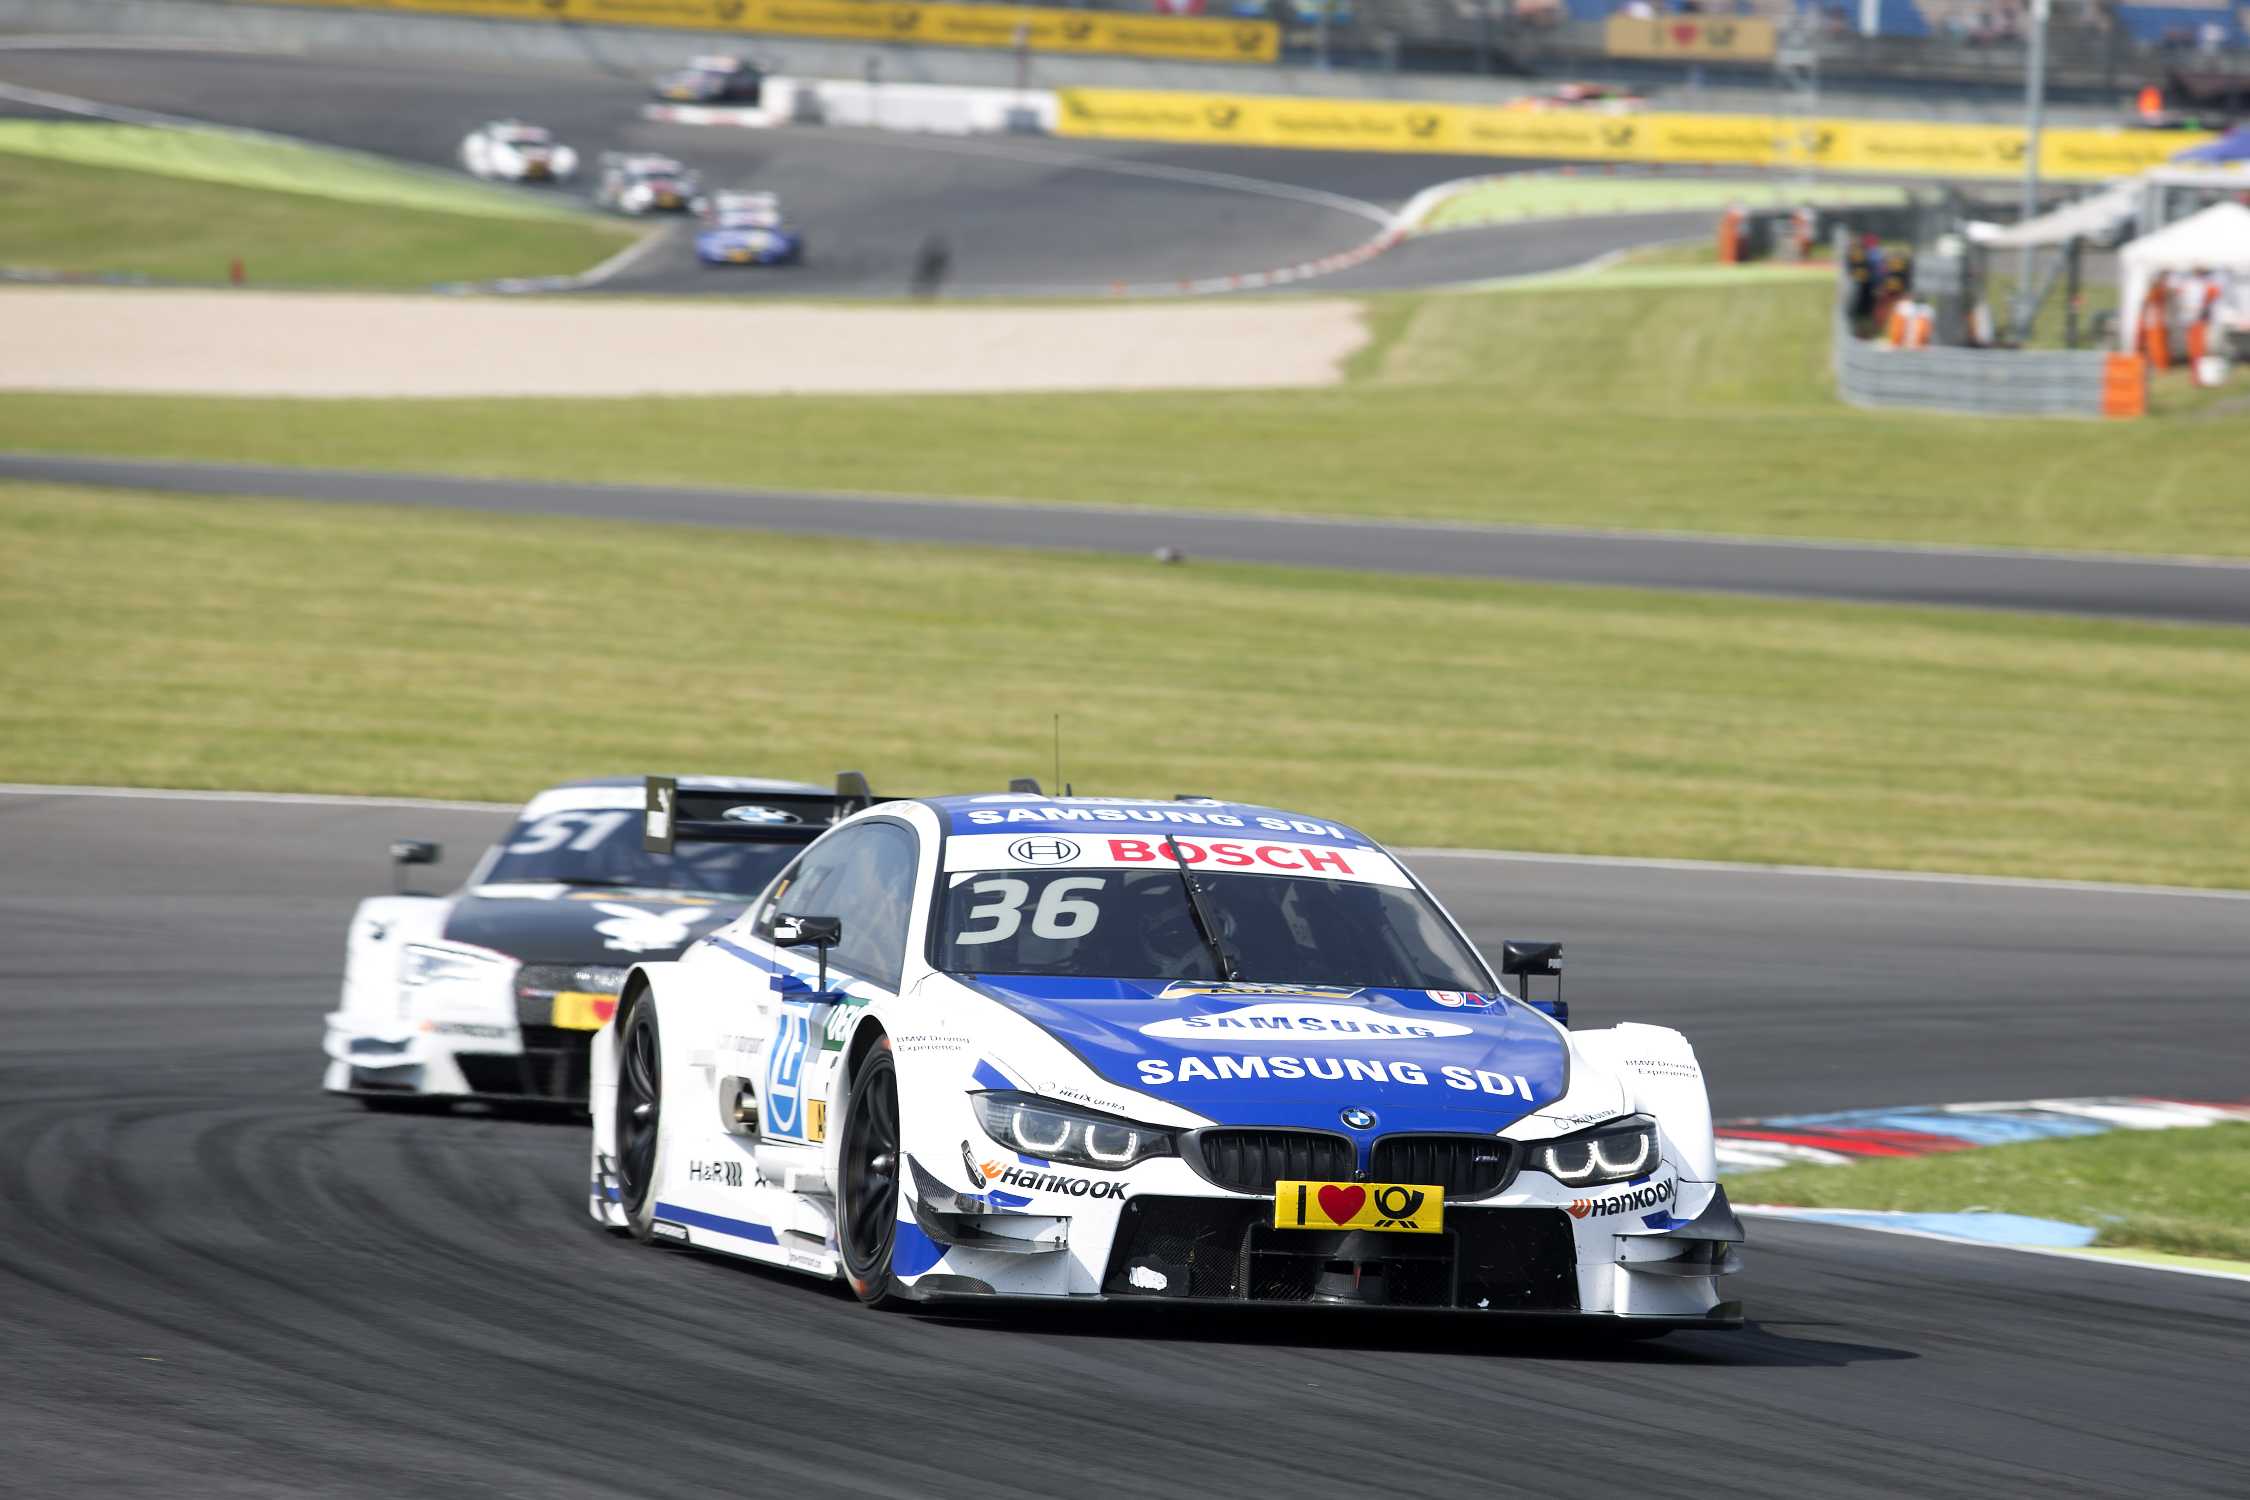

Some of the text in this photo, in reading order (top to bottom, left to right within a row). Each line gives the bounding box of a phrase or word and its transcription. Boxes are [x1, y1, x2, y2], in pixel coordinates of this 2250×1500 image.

[508, 810, 633, 855] 51
[967, 807, 1346, 840] SAMSUNG SDI
[1106, 838, 1355, 875] BOSCH
[955, 876, 1107, 946] 36
[1182, 1016, 1436, 1038] SAMSUNG
[1136, 1056, 1534, 1102] SAMSUNG SDI
[1296, 1184, 1307, 1226] I
